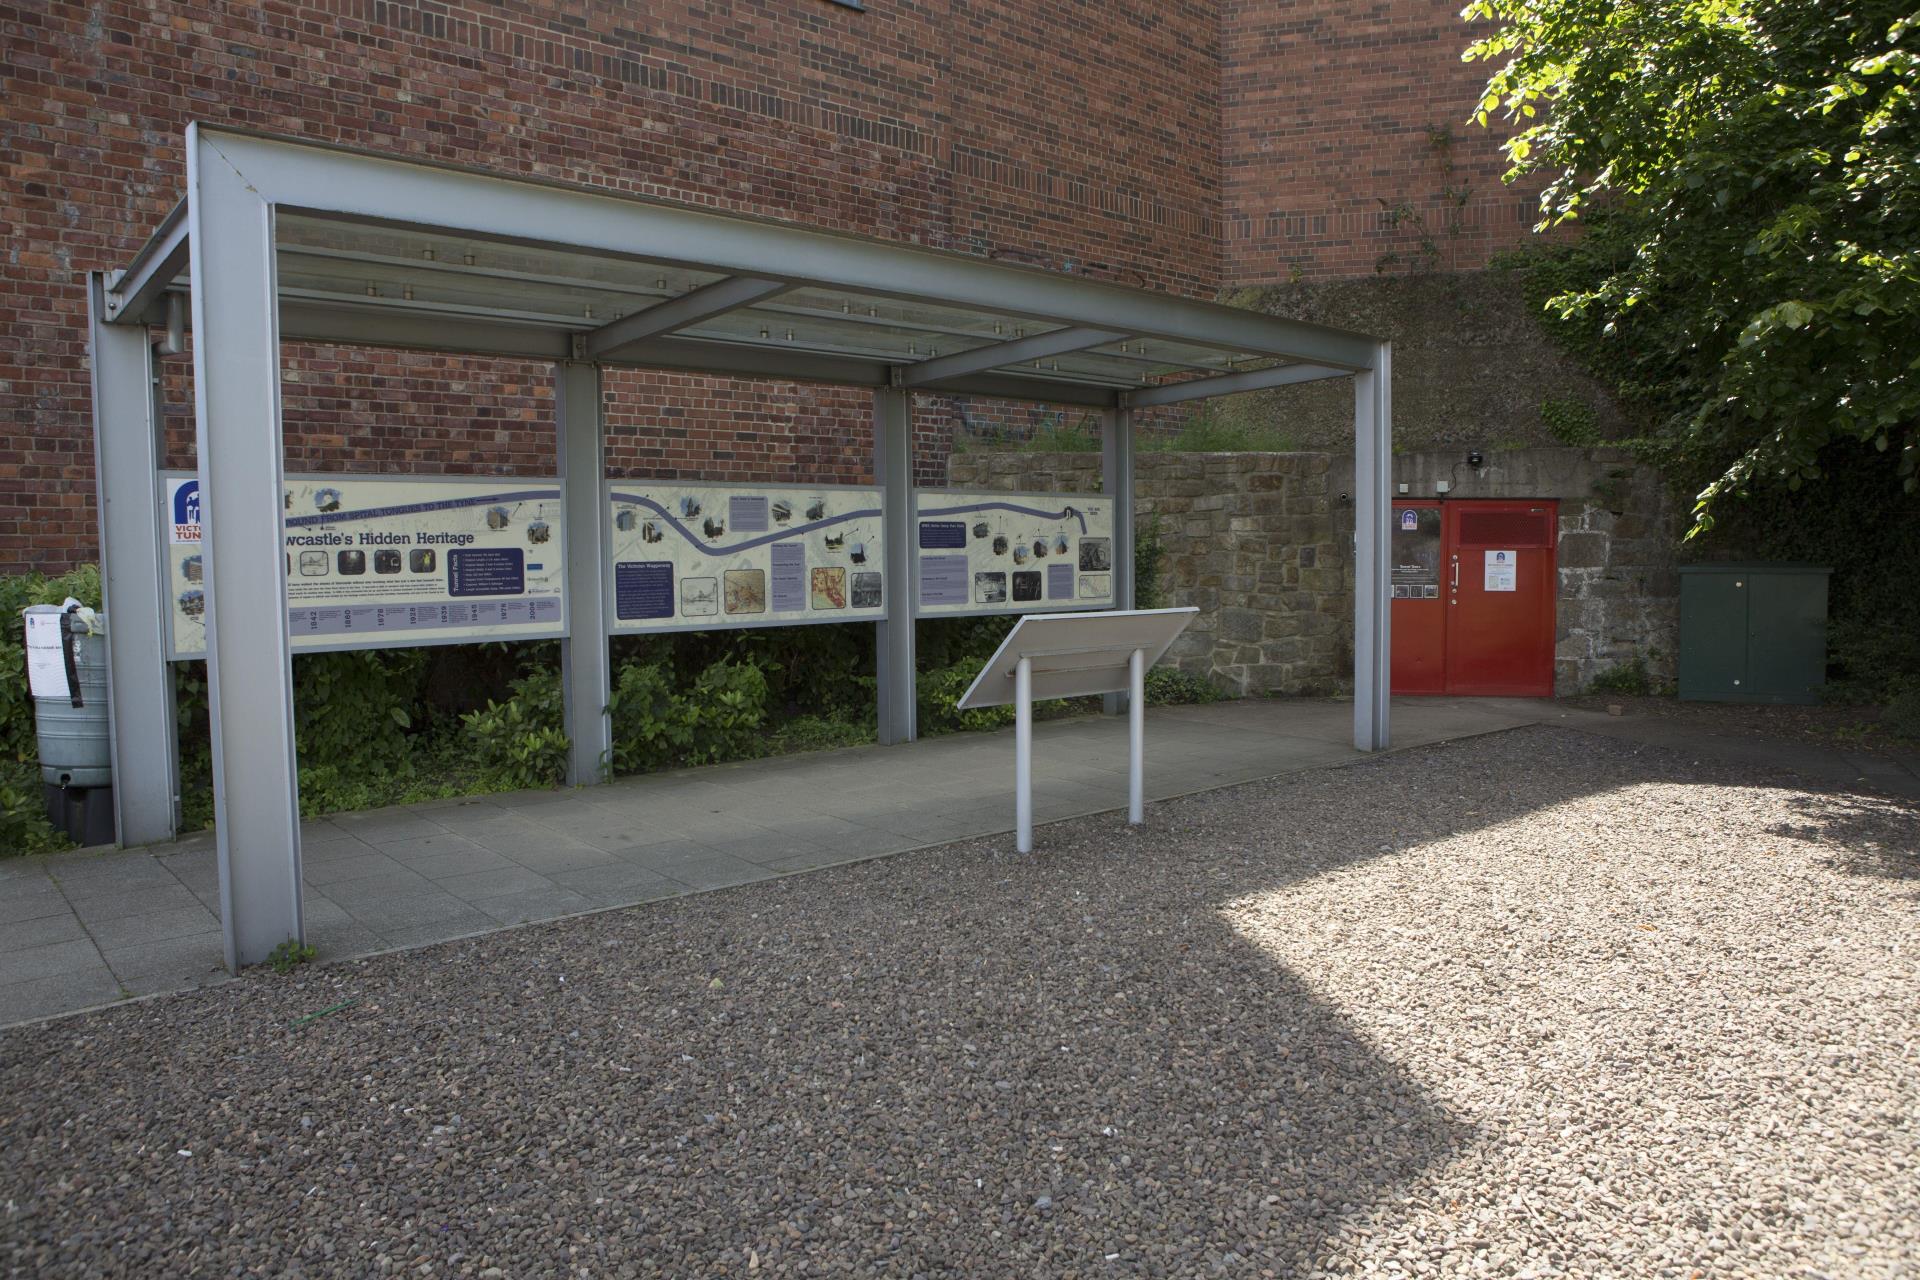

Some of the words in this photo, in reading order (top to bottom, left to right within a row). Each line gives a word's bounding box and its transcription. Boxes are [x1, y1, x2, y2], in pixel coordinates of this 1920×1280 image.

[286, 532, 353, 546] wcastle's
[359, 532, 411, 544] Hidden
[416, 532, 474, 546] Heritage
